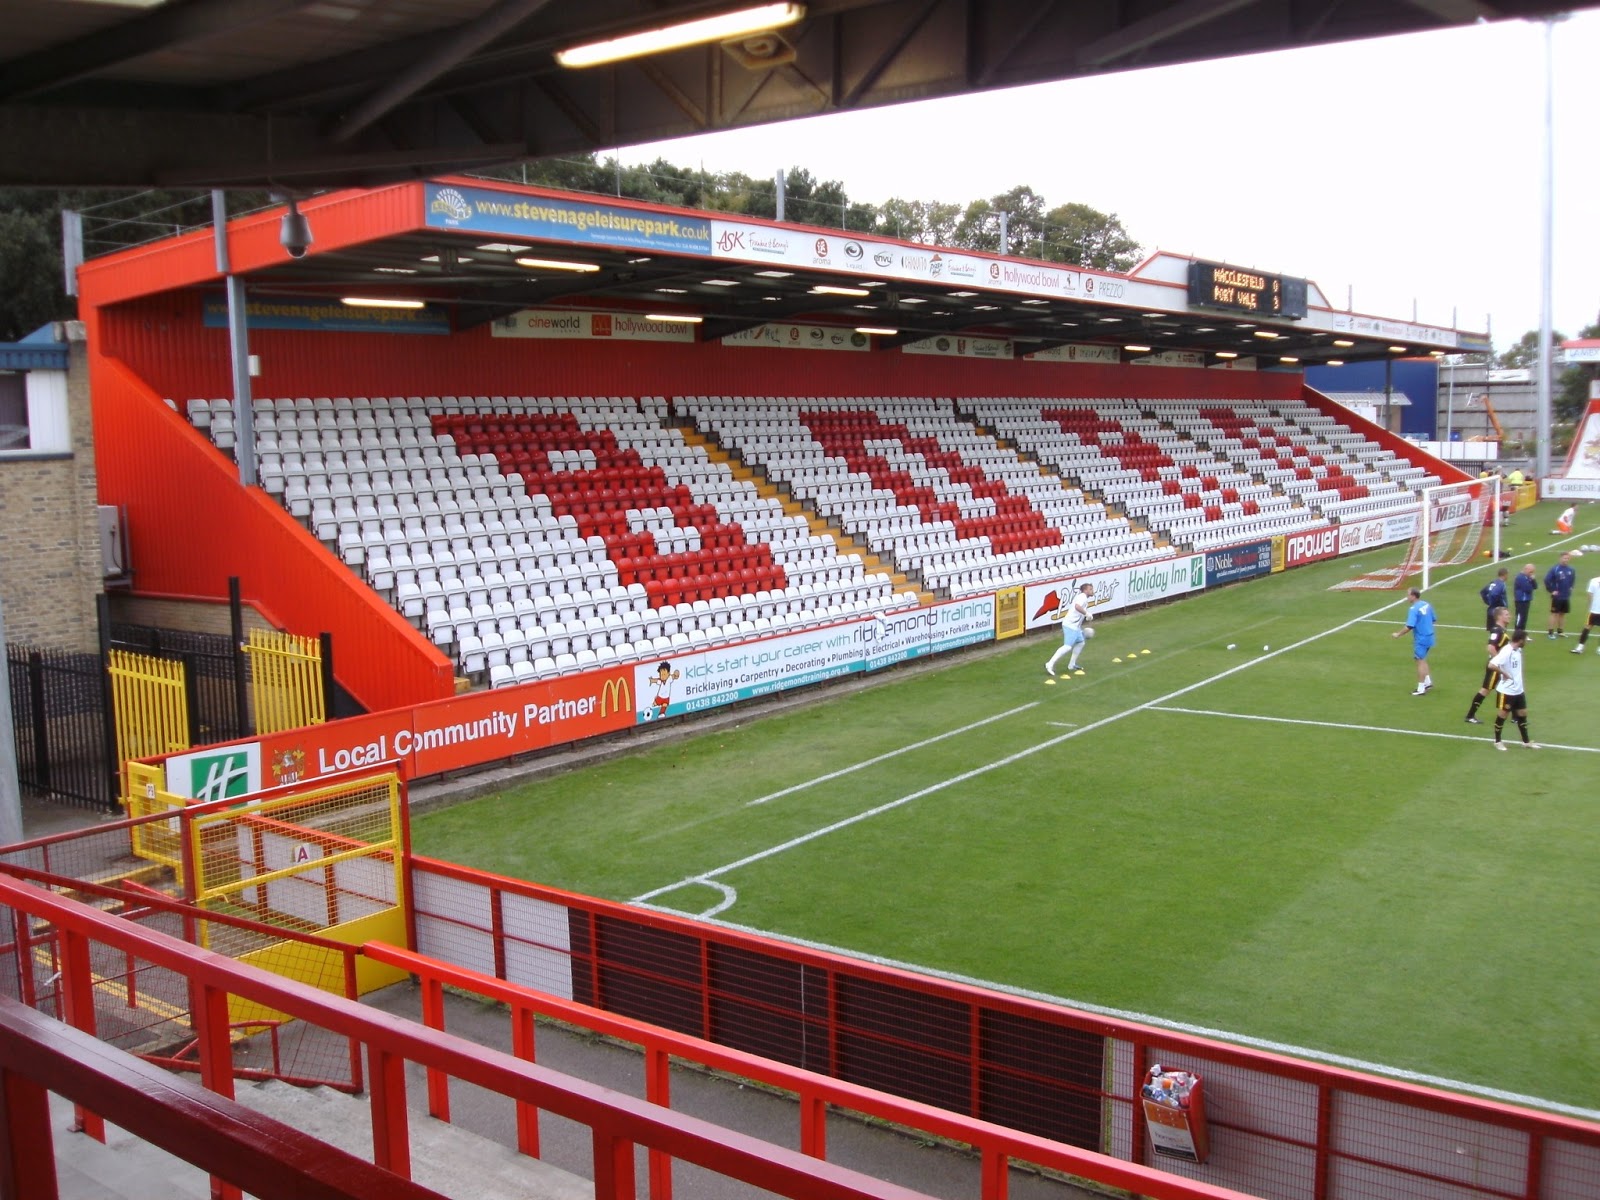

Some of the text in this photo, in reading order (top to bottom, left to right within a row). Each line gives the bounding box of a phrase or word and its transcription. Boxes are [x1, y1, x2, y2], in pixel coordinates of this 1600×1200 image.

[475, 200, 709, 240] www.stevenageleisurepark.co.uk
[716, 230, 745, 252] ASK
[1004, 266, 1059, 288] hollywood bowl
[1213, 268, 1265, 290] MACCLESFIELD
[1098, 281, 1124, 298] PREZZO
[528, 316, 580, 329] cineworld
[615, 317, 687, 336] hollywood bowl
[1560, 484, 1594, 492] GREENE
[1436, 502, 1471, 522] MBDA
[1215, 553, 1233, 570] Noble
[1128, 563, 1187, 593] Holiday Inn
[685, 663, 714, 679] kick
[717, 654, 749, 672] start
[752, 649, 782, 667] your
[784, 640, 823, 658] career
[826, 634, 850, 648] with
[941, 601, 992, 623] training
[686, 678, 733, 695] Bricklaying
[740, 667, 779, 683] Carpentry
[785, 657, 826, 672] Decorating
[832, 646, 864, 663] Plumbing
[872, 639, 901, 655] Electrical
[950, 623, 970, 634] Forklift
[975, 619, 991, 629] Retail
[686, 697, 710, 711] 01438
[712, 691, 739, 705] 842200
[752, 665, 850, 695] www.ridgemondtraining.org.uk
[318, 735, 387, 774] Local
[394, 711, 517, 755] Community
[524, 695, 596, 729] Partner
